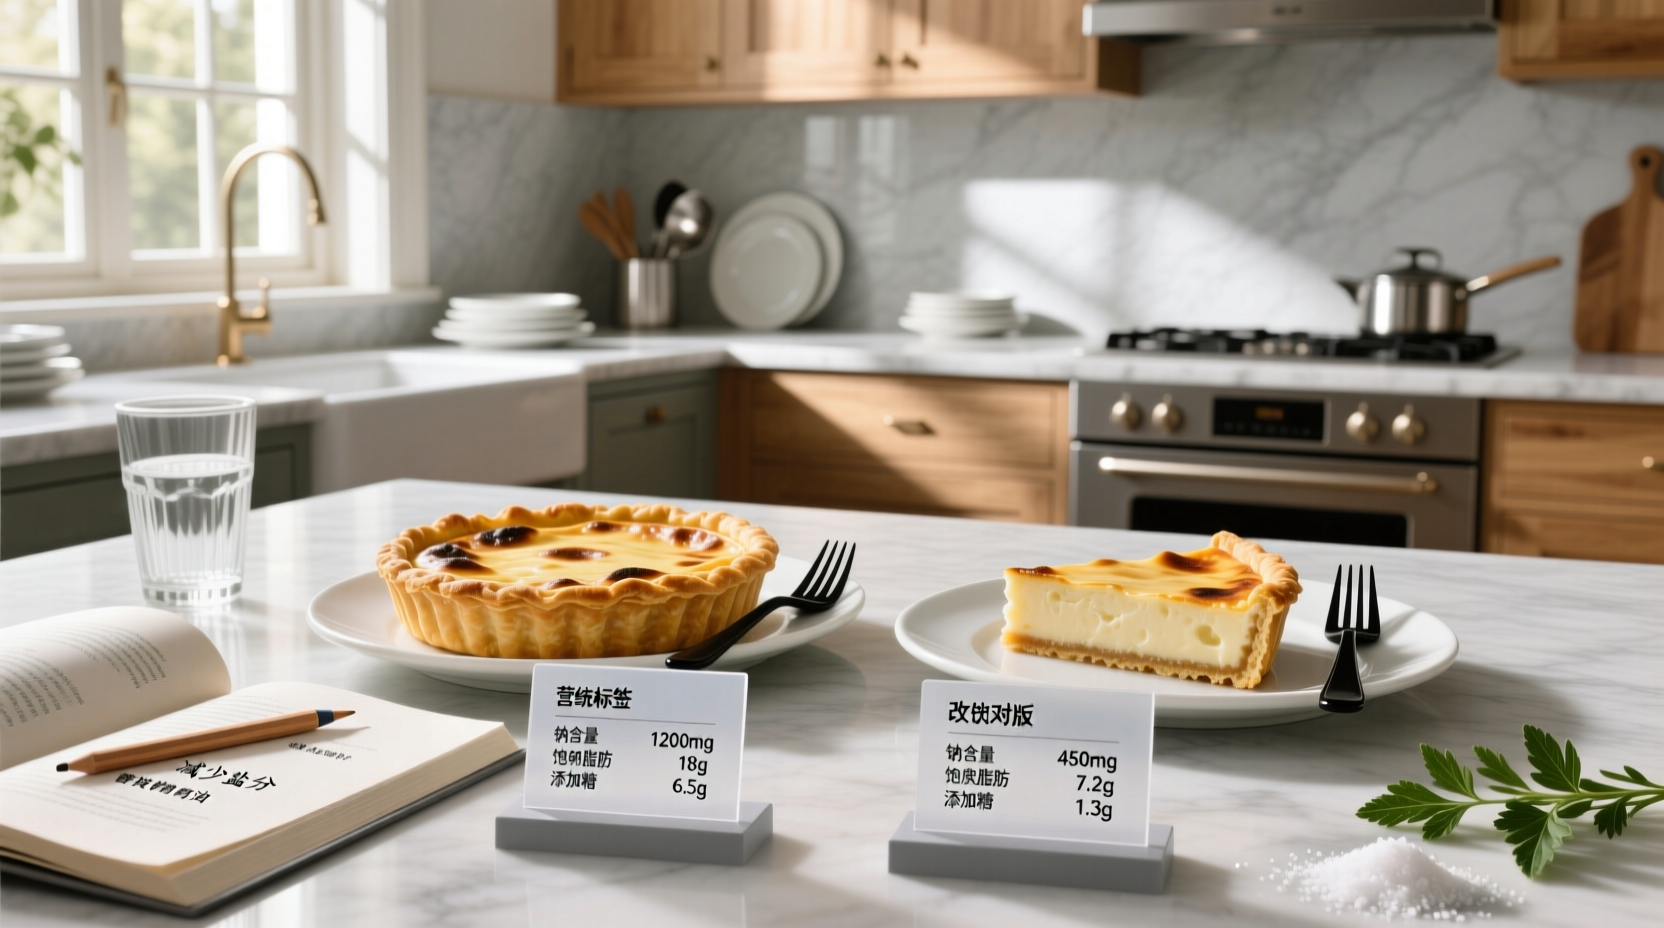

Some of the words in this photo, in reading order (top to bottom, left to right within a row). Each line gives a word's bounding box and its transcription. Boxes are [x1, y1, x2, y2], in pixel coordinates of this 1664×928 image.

[651, 731, 714, 754] 1200mg
[679, 755, 708, 776] 18g
[1057, 749, 1118, 773] 450mg
[672, 778, 708, 800] 6.5g
[1076, 774, 1115, 798] 7.2g
[1075, 798, 1113, 822] 1.3g
